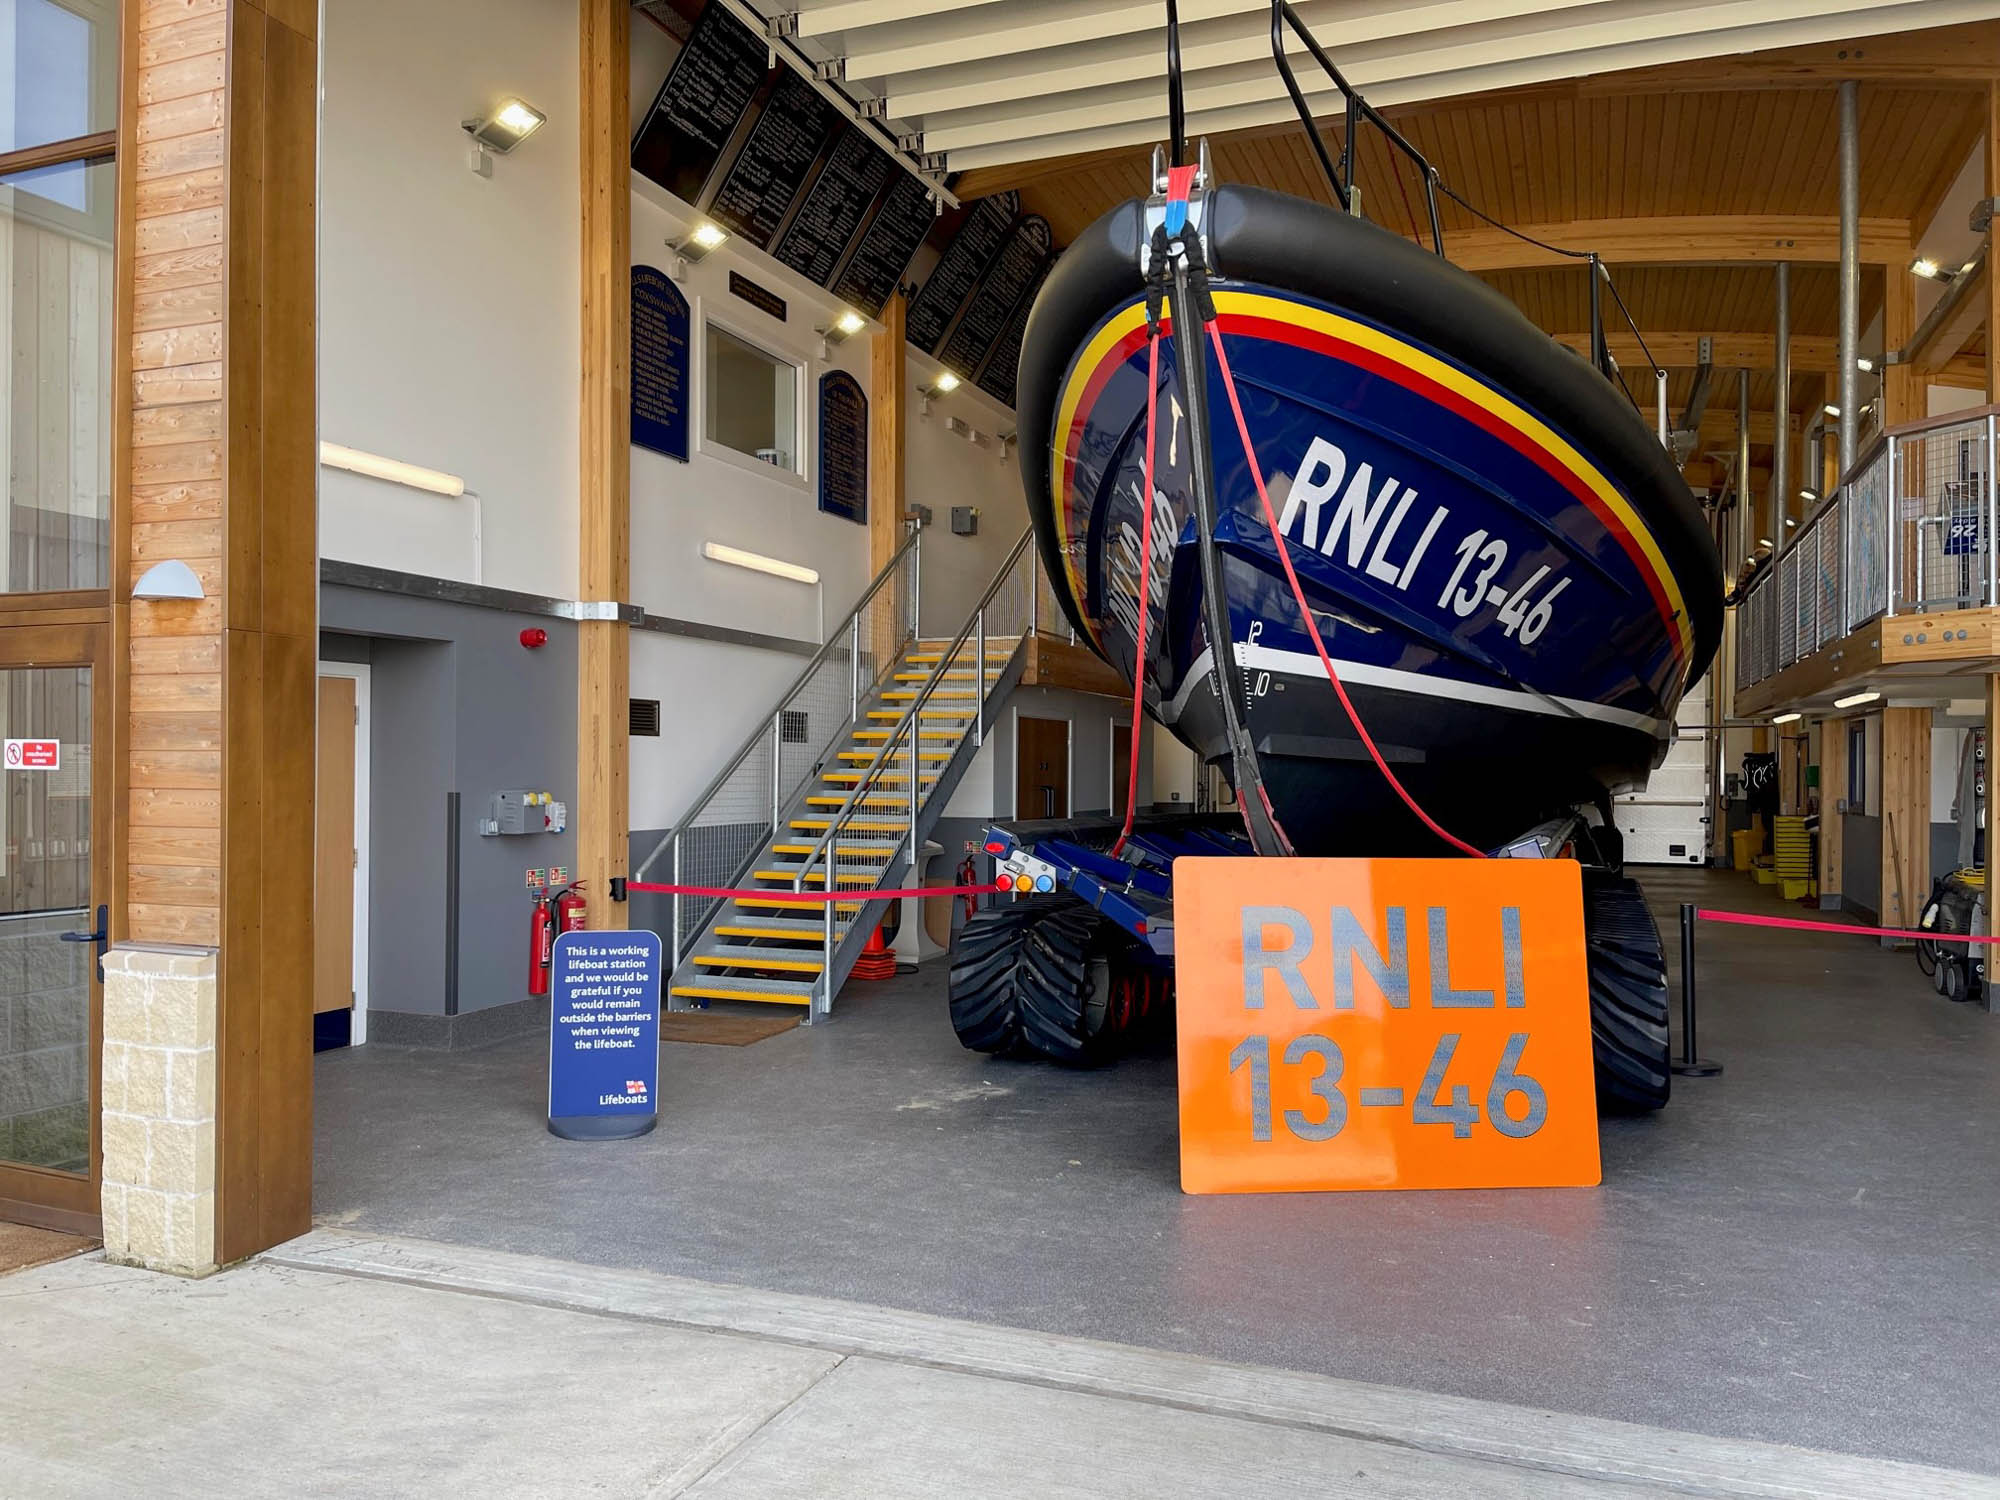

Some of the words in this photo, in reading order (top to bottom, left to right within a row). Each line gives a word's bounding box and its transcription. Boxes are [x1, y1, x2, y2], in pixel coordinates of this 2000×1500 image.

[635, 288, 676, 315] COXSWAINS
[1278, 436, 1450, 591] RNLI
[1437, 529, 1573, 646] 13-46
[1247, 620, 1263, 647] 12
[1254, 671, 1271, 697] 10
[566, 946, 588, 956] This
[589, 946, 599, 956] is
[599, 948, 607, 956] a
[608, 945, 650, 958] working
[1241, 905, 1526, 1010] RNLI
[568, 959, 609, 970] lifeboat
[610, 958, 646, 969] station
[564, 972, 584, 983] and
[585, 975, 602, 983] we
[602, 971, 635, 982] would
[636, 971, 649, 982] be
[570, 985, 612, 999] grateful
[613, 985, 622, 995] if
[622, 987, 642, 998] you
[571, 999, 604, 1010] would
[605, 998, 641, 1009] remain
[559, 1012, 596, 1023] outside
[596, 1012, 614, 1022] the
[615, 1011, 652, 1022] barriers
[571, 1026, 599, 1036] when
[600, 1025, 640, 1037] viewing
[574, 1039, 592, 1050] the
[593, 1038, 636, 1049] lifeboat.
[1229, 1032, 1548, 1142] 13-46
[599, 1094, 648, 1105] Lifeboats
